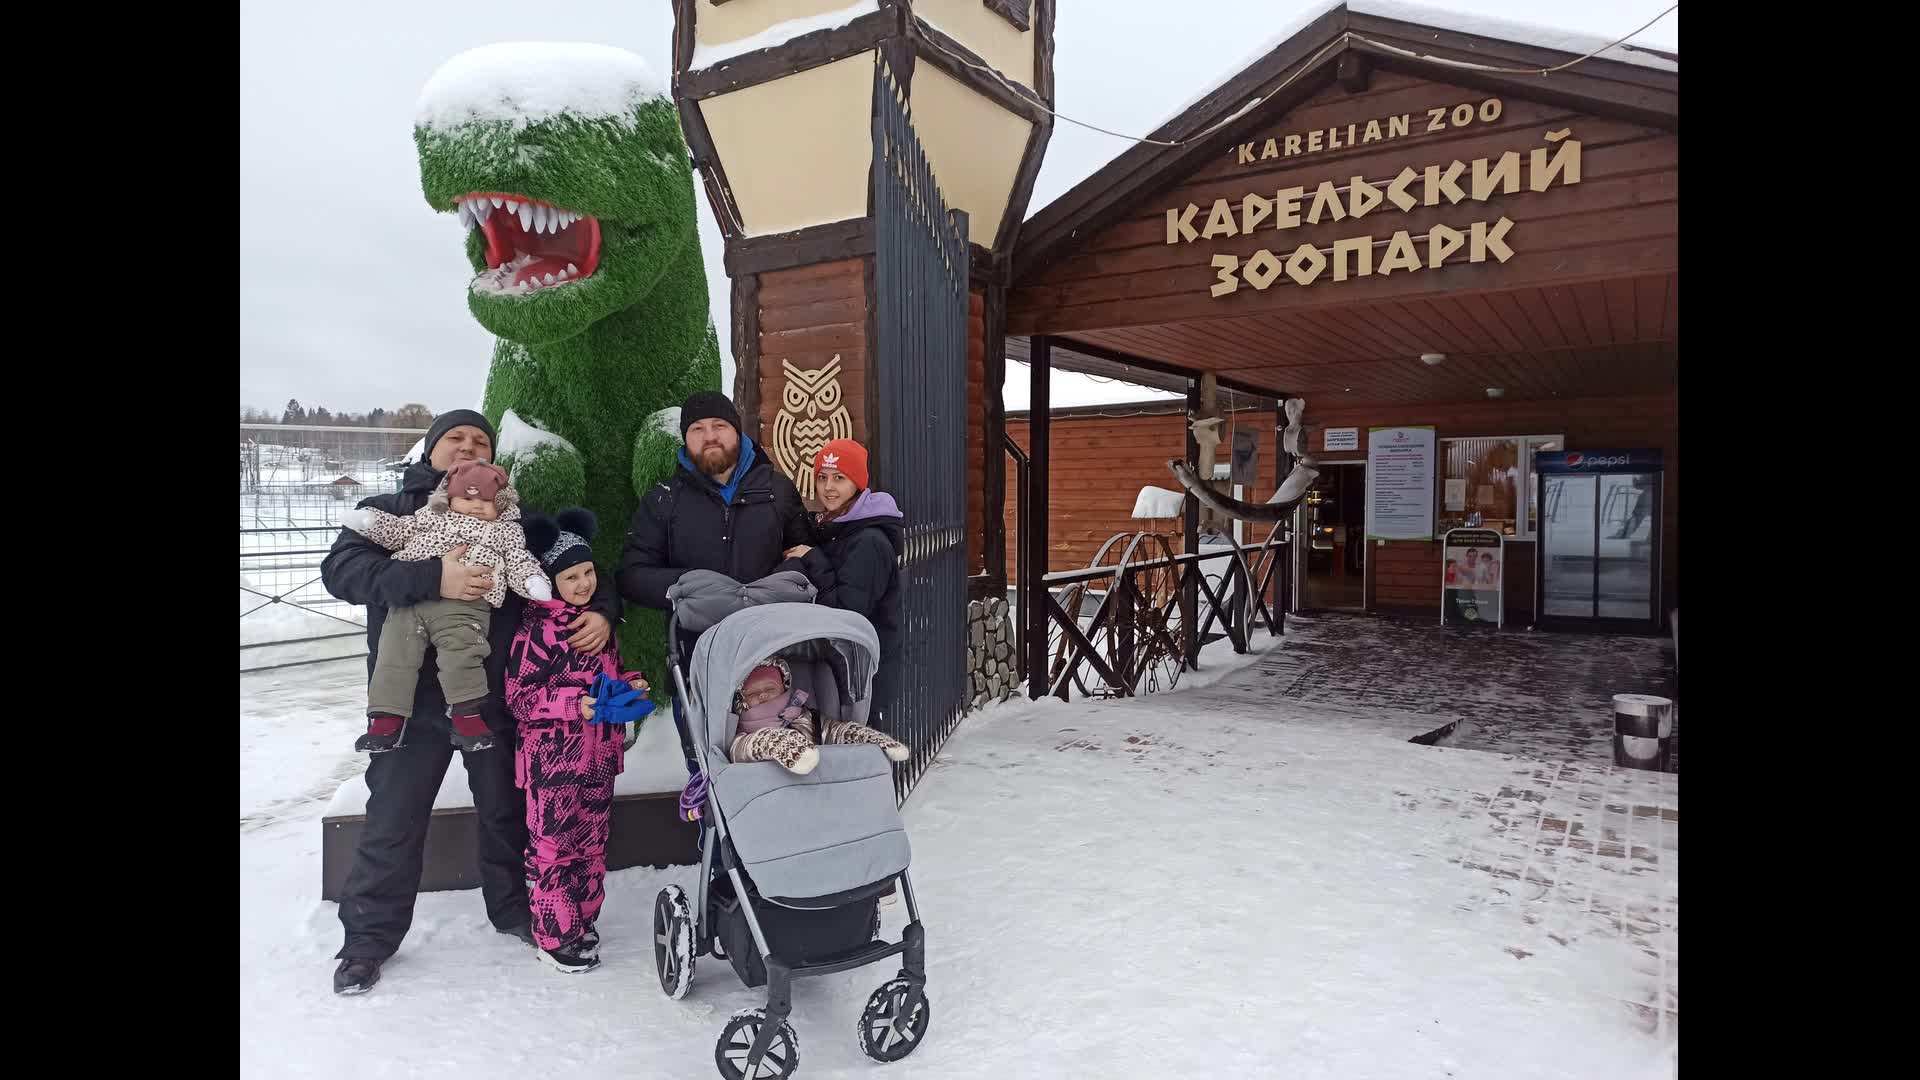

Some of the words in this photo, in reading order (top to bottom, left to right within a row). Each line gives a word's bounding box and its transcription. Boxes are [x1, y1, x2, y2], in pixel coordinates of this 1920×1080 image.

[1238, 114, 1410, 165] KARELIAN
[1427, 98, 1502, 132] ZOO
[1166, 127, 1582, 244] КАРЕЛЬСКИЙ
[1210, 216, 1515, 298] ЗООПАРК
[1587, 454, 1631, 467] pepsi
